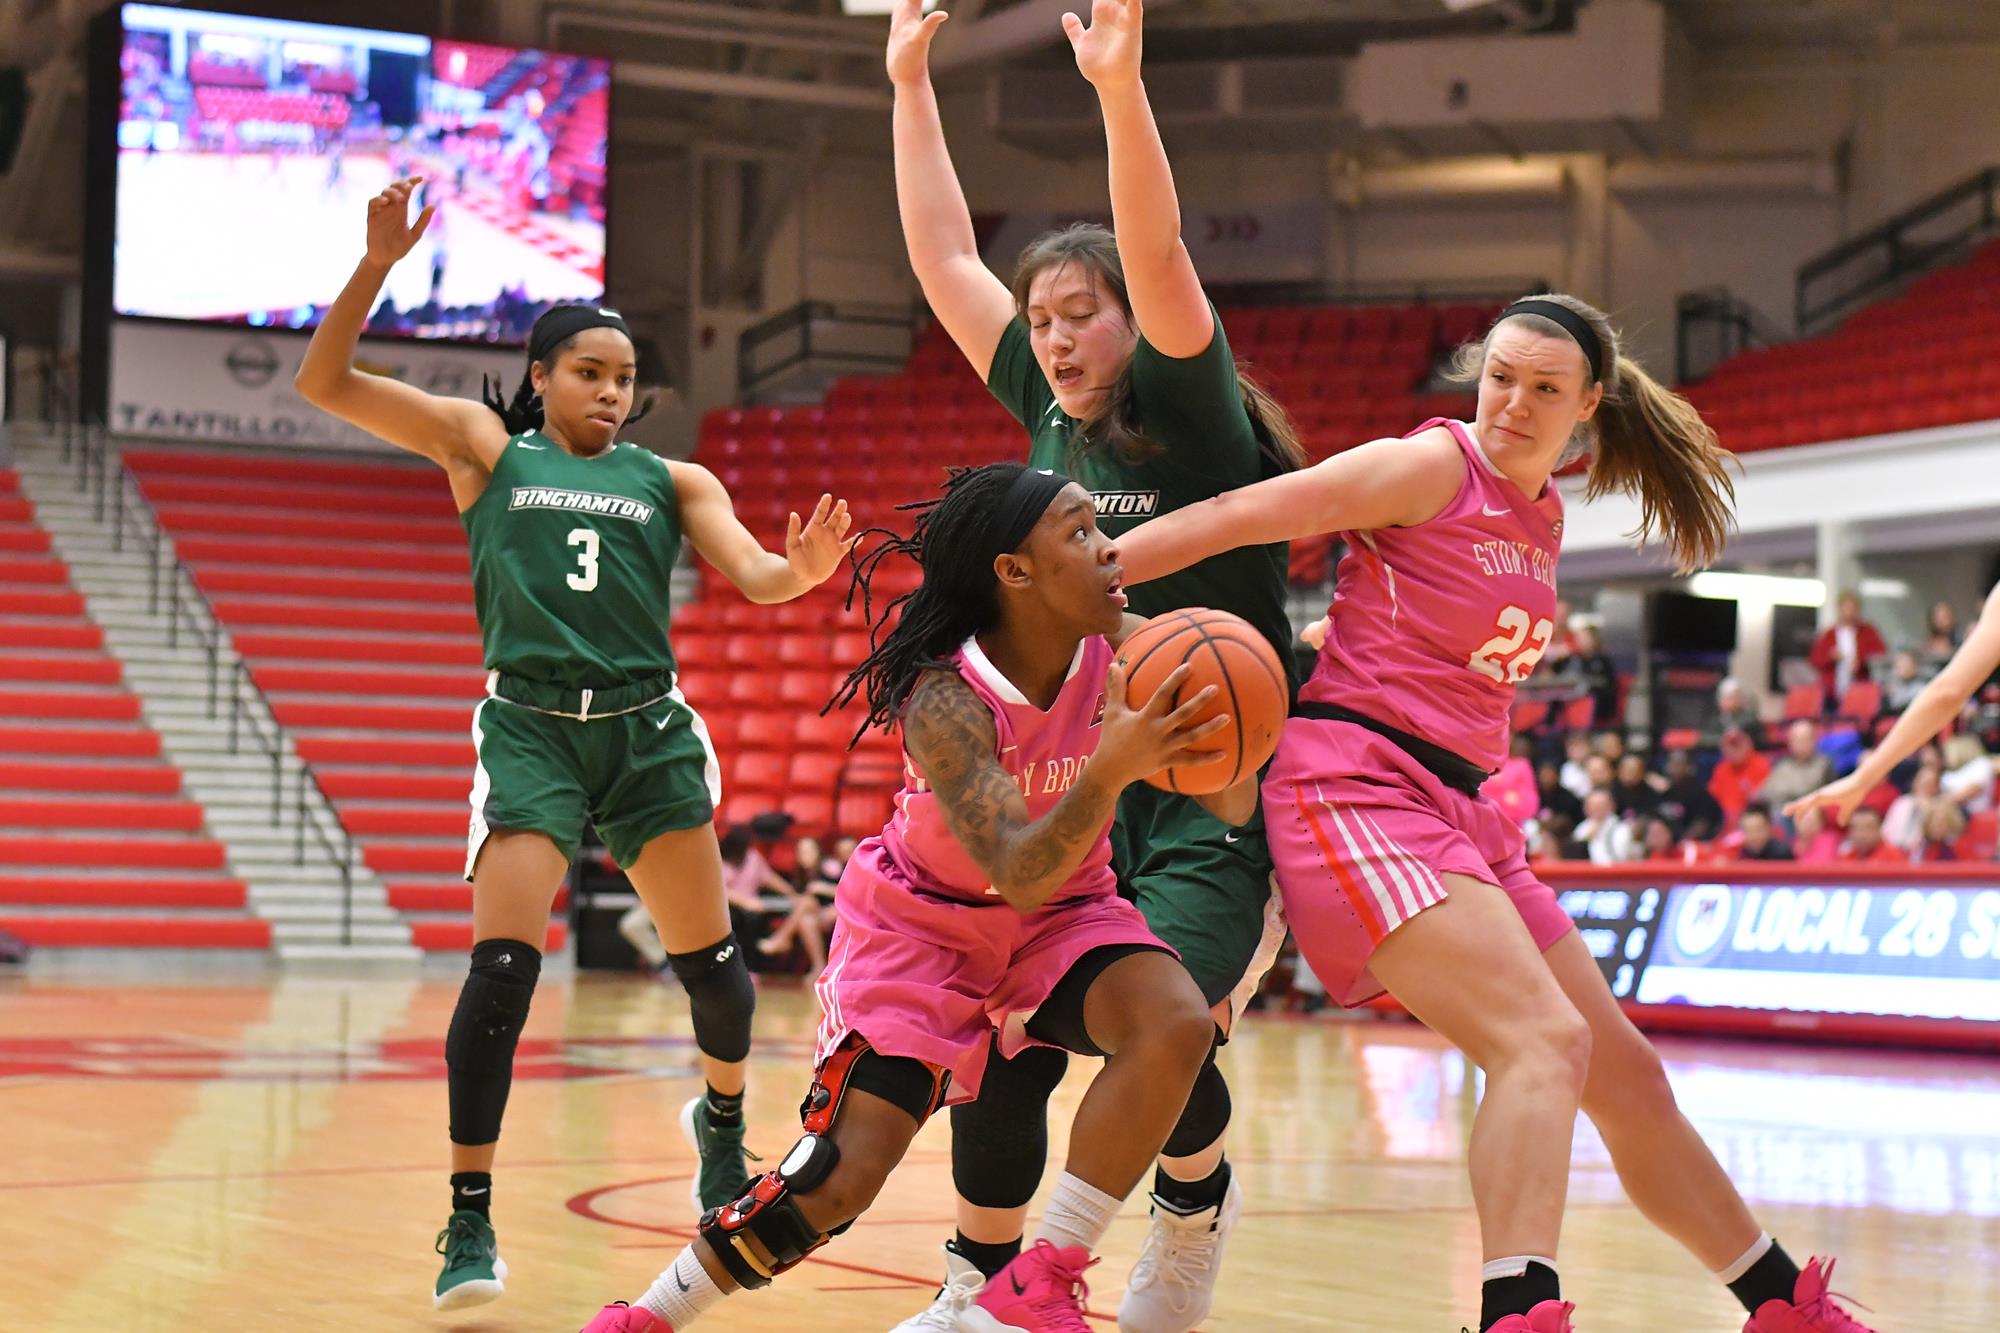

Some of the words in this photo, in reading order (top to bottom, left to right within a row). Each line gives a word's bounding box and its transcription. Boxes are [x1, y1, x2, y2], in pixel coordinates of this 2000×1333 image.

[513, 489, 650, 521] BINGHAMTON
[566, 528, 600, 592] 3
[1472, 539, 1529, 577] STONY
[1465, 604, 1554, 684] 22
[1732, 888, 1872, 955] LOCAL
[1878, 889, 1957, 958] 28
[1960, 889, 2000, 960] S
